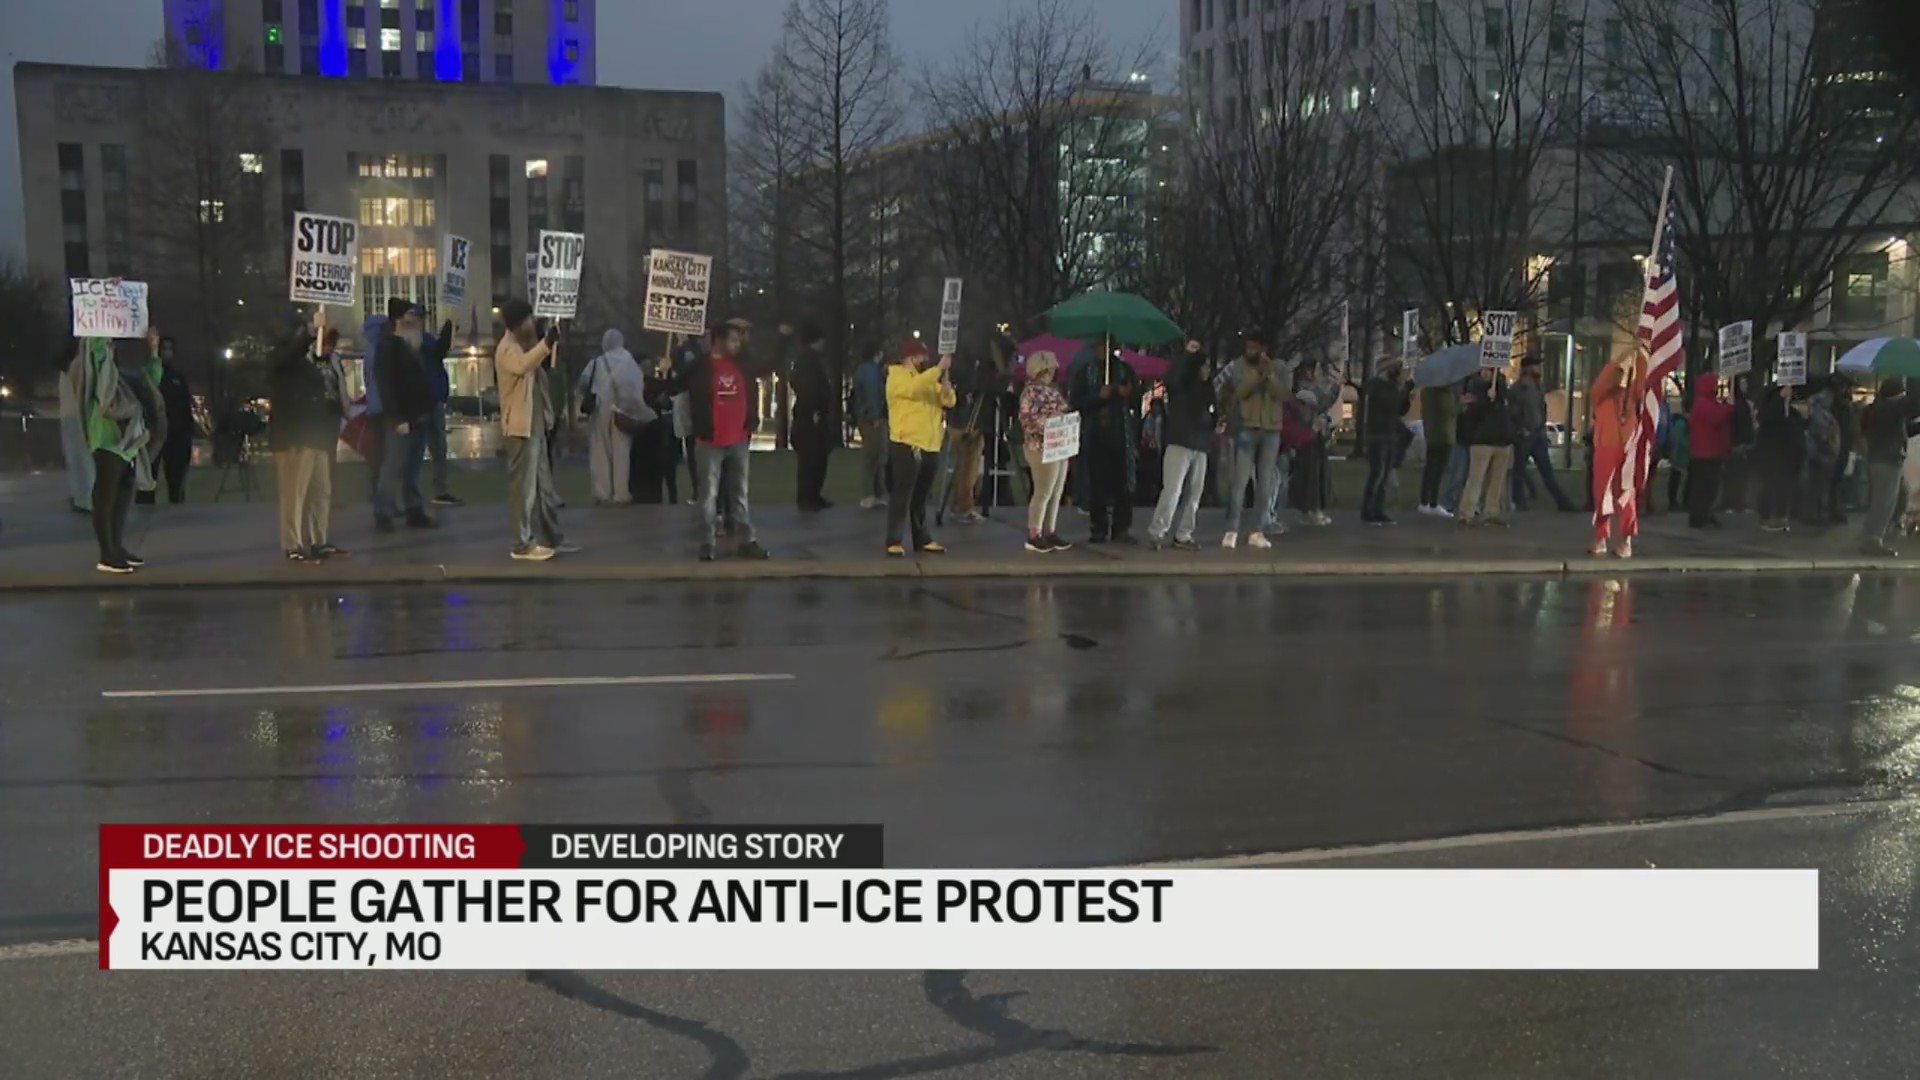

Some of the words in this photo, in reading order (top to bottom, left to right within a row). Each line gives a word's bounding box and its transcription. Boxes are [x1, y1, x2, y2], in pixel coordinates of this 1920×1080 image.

[297, 217, 356, 256] STOP
[541, 234, 582, 271] STOP
[296, 260, 313, 277] ICE
[653, 258, 686, 275] KANSAS
[687, 263, 708, 277] CITY
[74, 279, 117, 296] ICE
[650, 292, 705, 308] STOP
[648, 304, 663, 319] ICE
[665, 306, 703, 323] TERROR
